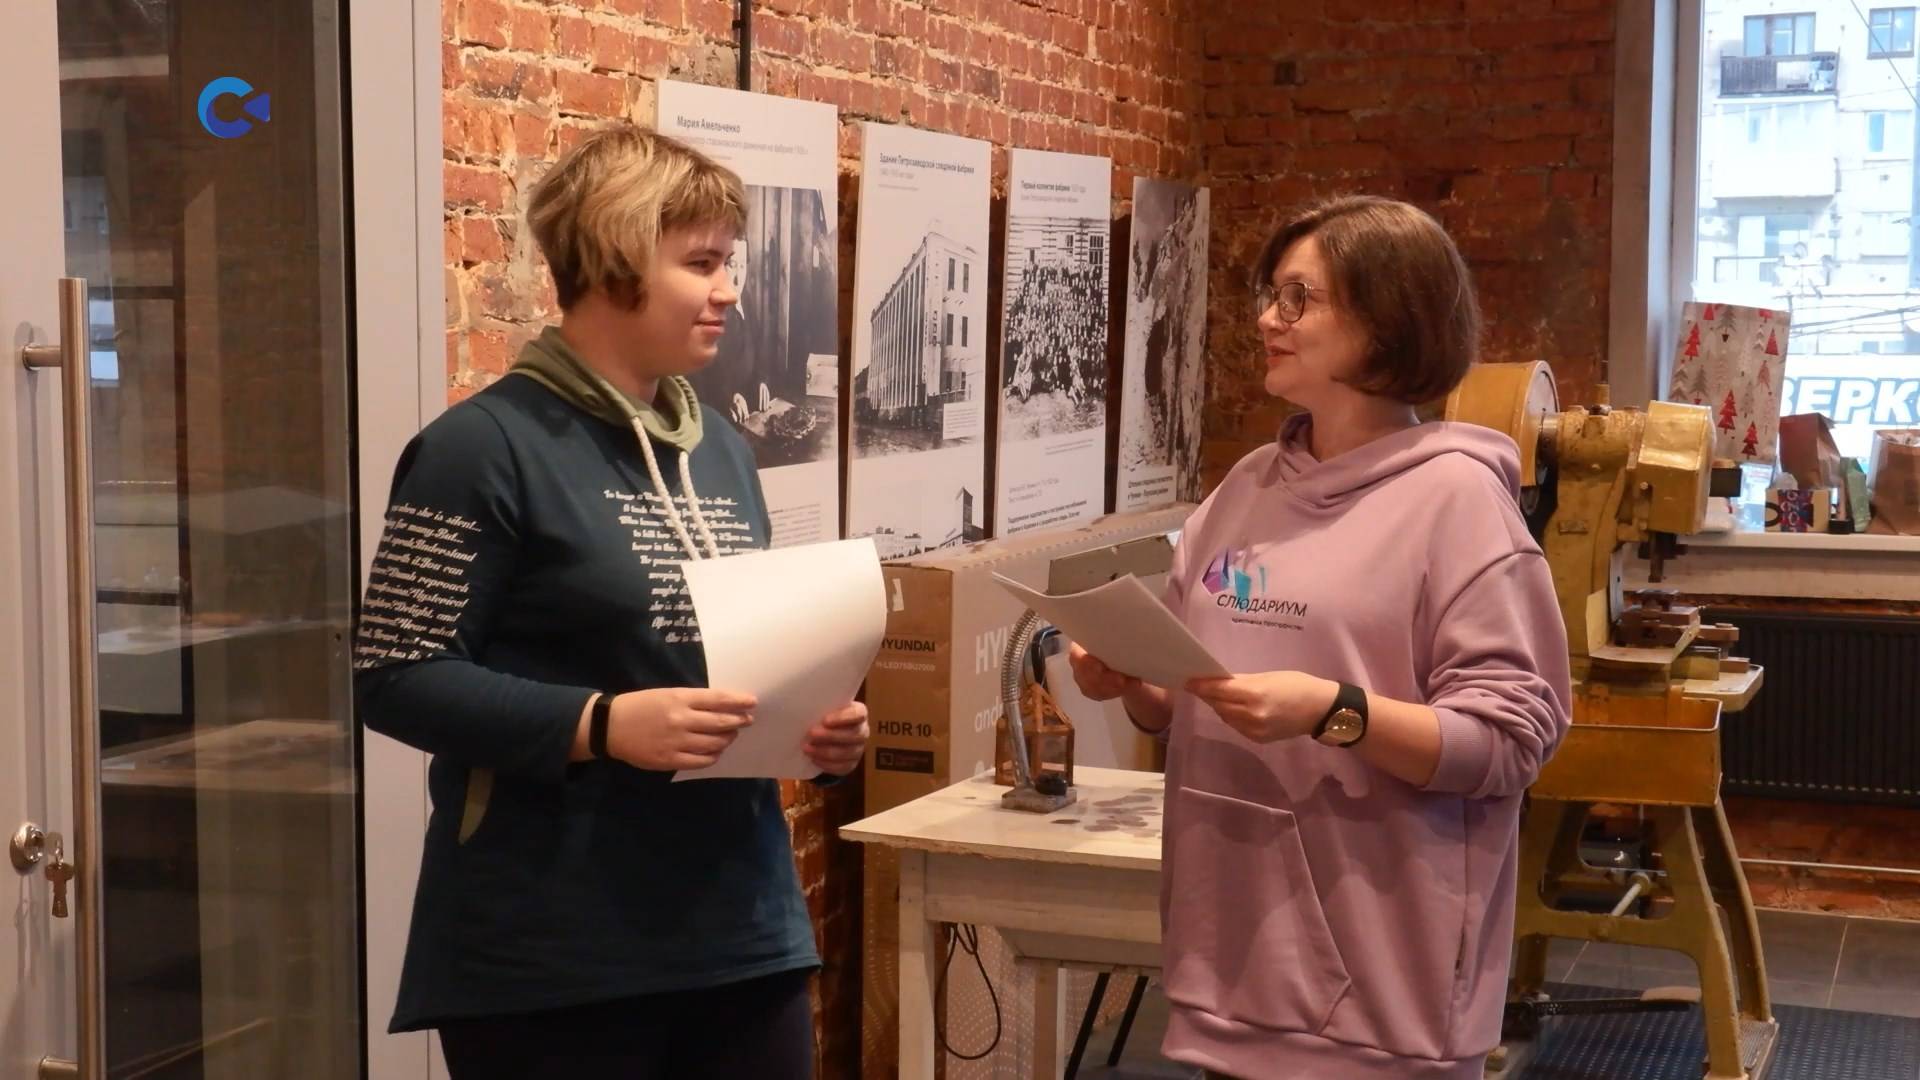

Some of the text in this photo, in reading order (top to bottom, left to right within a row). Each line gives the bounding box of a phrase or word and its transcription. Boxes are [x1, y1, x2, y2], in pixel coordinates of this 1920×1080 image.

[677, 115, 700, 129] Мария
[1779, 376, 1920, 425] ЕРК
[434, 510, 444, 521] is
[417, 576, 470, 592] reproach
[1217, 594, 1307, 617] СЛЮДАРИУМ
[878, 720, 931, 738] HDR 10
